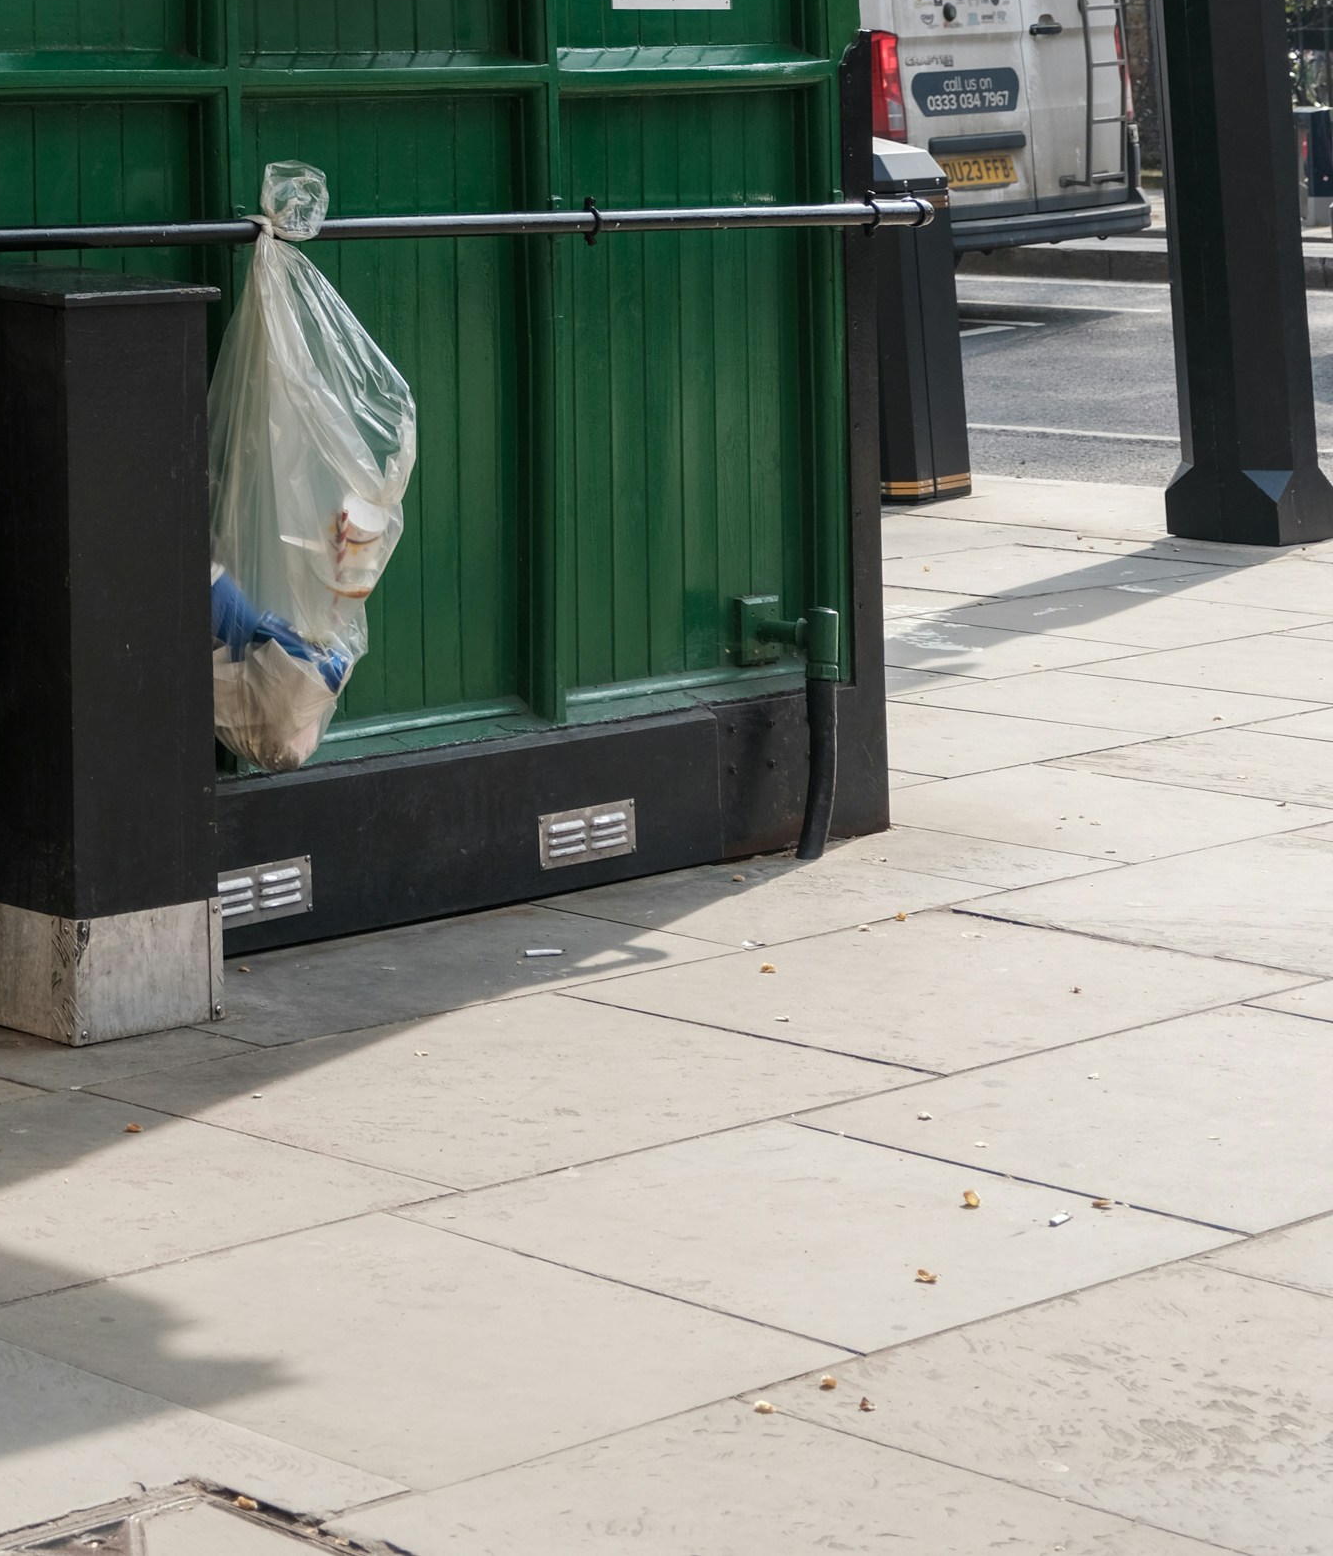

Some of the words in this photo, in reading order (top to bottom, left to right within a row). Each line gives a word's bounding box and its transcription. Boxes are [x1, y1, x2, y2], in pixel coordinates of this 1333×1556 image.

[943, 76, 962, 92] call
[964, 78, 977, 90] us
[979, 77, 992, 89] on
[927, 94, 957, 111] 0333
[959, 92, 981, 108] 034
[982, 90, 1009, 107] 7967
[943, 160, 983, 182] DU23
[983, 157, 1011, 178] FFB
